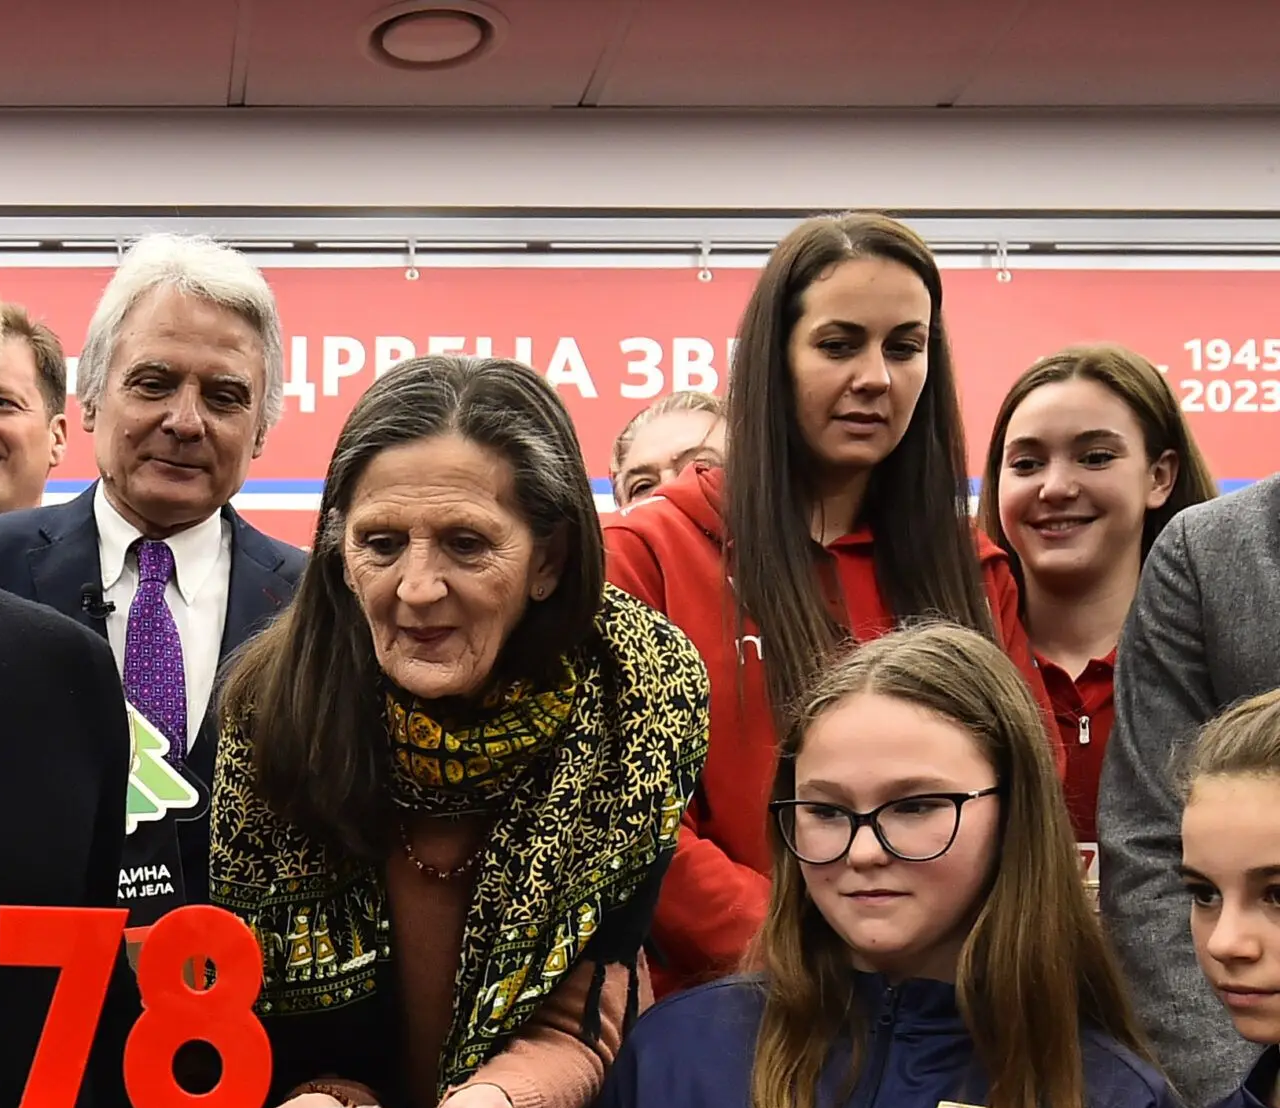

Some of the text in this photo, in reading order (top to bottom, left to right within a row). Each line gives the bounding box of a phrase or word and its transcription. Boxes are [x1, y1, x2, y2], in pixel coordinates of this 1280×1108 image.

[1183, 338, 1280, 372] 1945
[1180, 379, 1280, 412] 2023
[126, 886, 137, 899] И
[139, 882, 175, 897] ЈЕЛА
